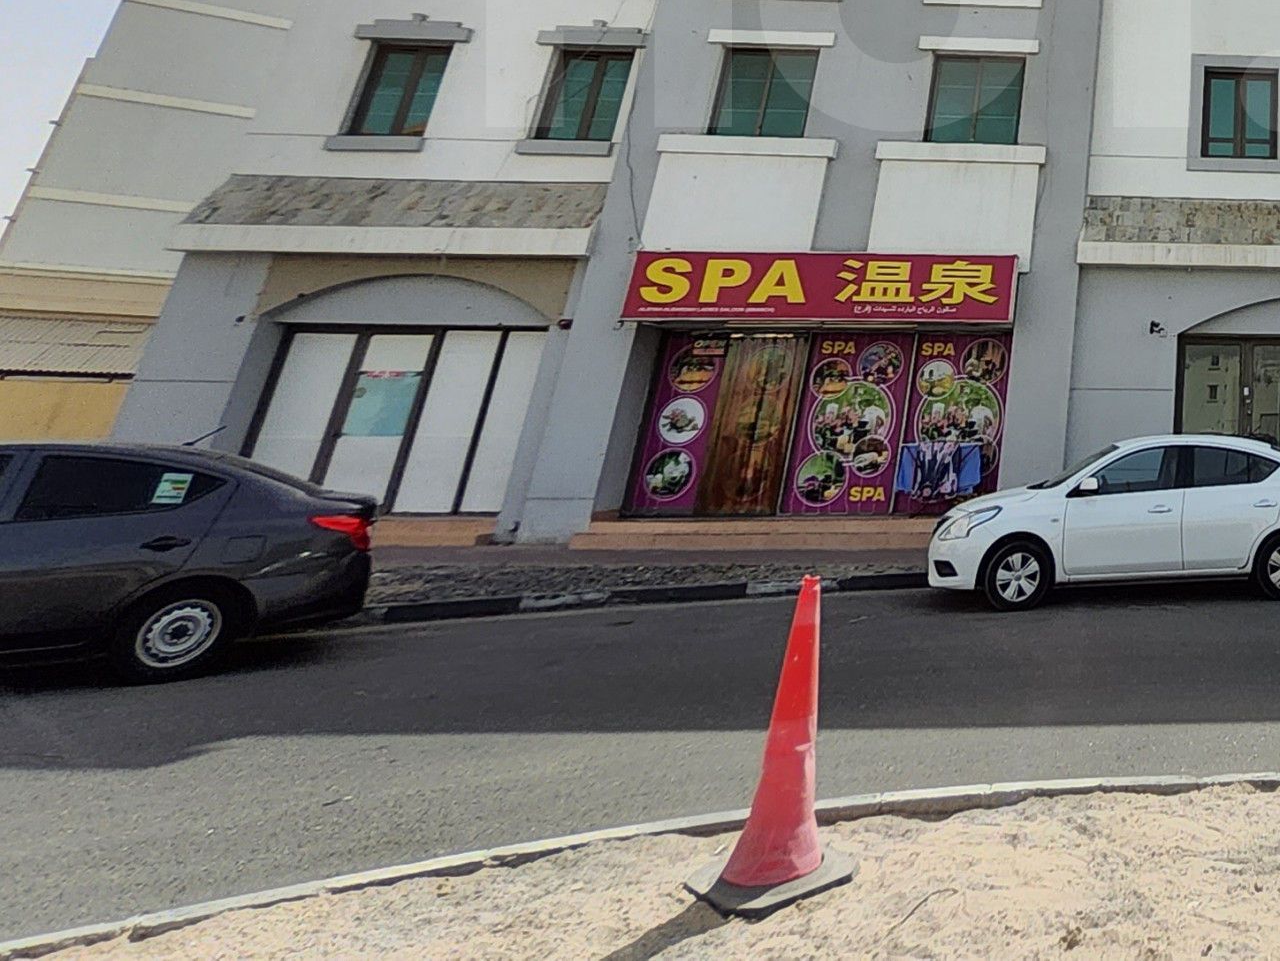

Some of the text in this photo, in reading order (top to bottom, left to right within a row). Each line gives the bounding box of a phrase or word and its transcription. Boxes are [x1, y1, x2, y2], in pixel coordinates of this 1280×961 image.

[639, 258, 806, 304] SPA
[834, 259, 999, 305] 温泉
[821, 340, 856, 354] SPA
[921, 342, 955, 356] SPA
[848, 485, 886, 502] SPA
